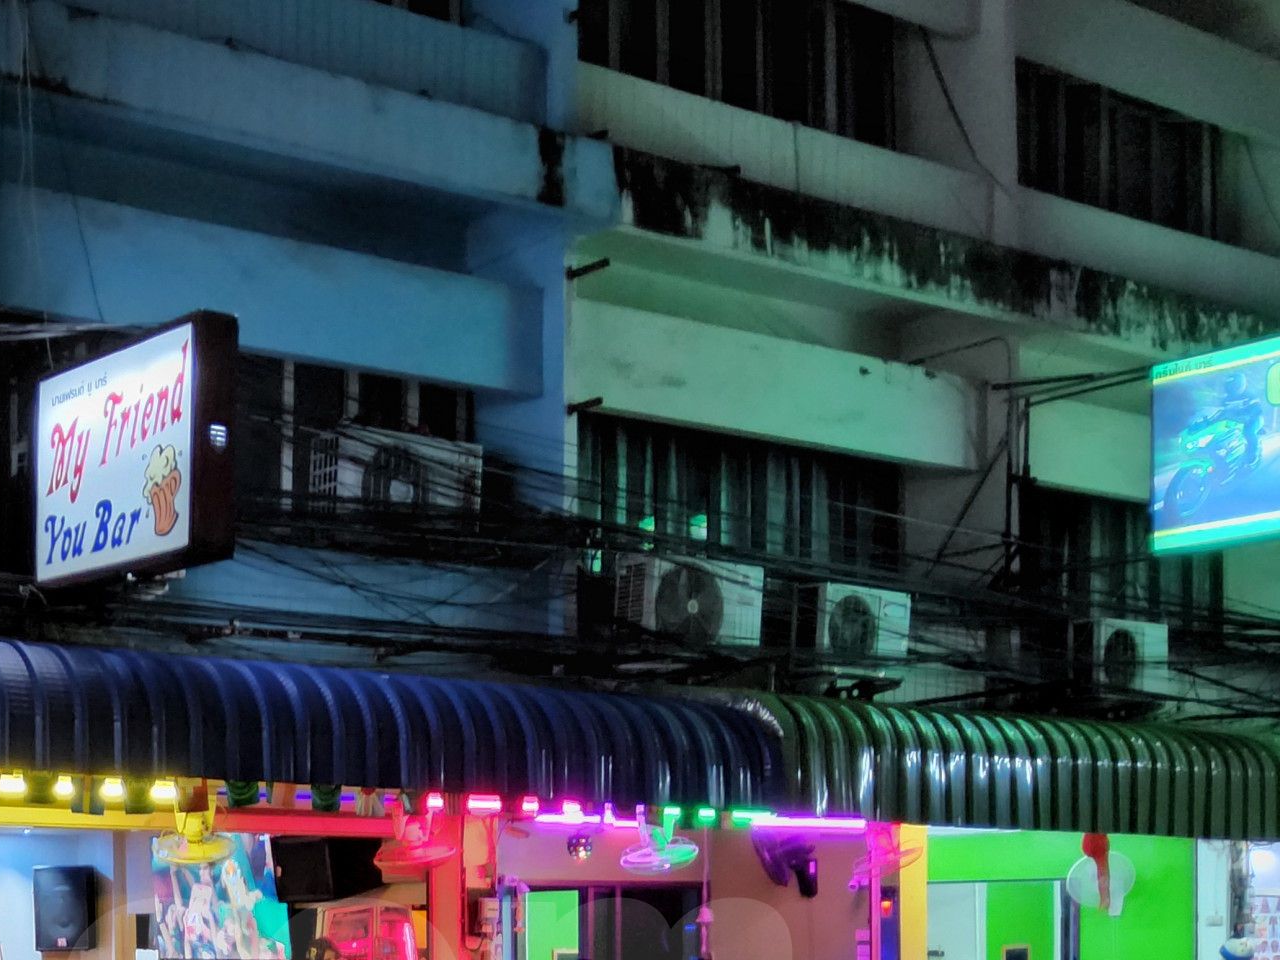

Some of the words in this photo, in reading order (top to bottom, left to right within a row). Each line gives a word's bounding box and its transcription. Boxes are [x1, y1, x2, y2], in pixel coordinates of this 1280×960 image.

[46, 415, 92, 504] My
[99, 338, 189, 468] Friend
[44, 513, 88, 566] You
[90, 498, 141, 554] Bar
